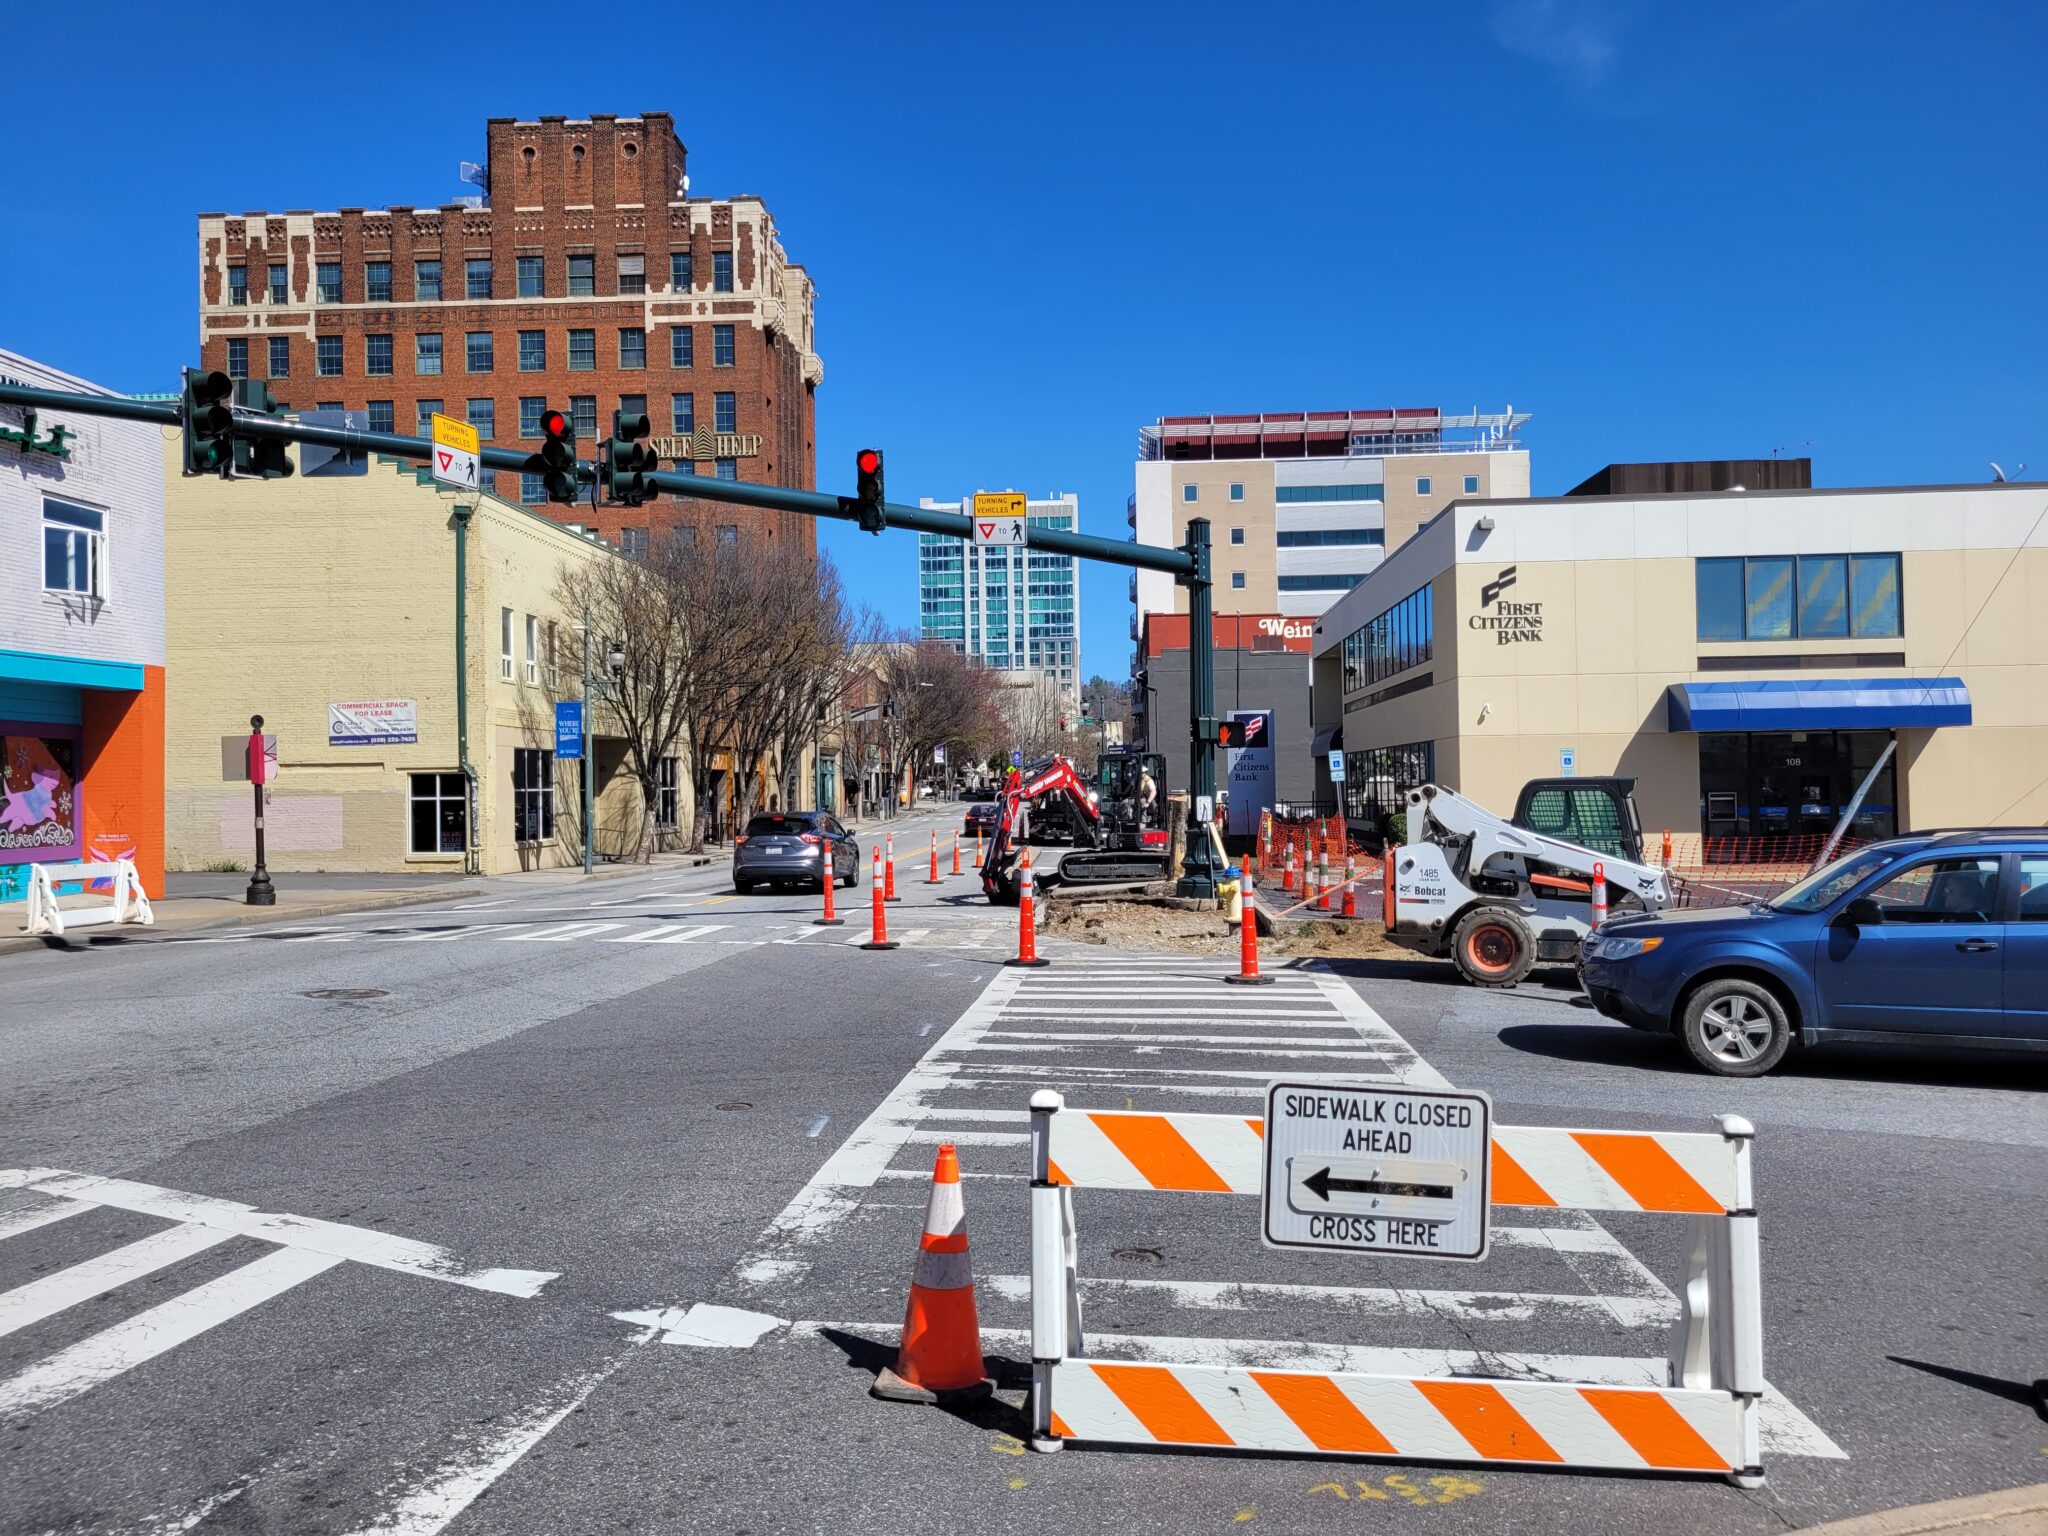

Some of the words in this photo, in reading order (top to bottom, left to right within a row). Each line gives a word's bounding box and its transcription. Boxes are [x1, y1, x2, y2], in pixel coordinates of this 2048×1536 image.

[442, 422, 469, 437] TURNING
[442, 433, 471, 448] VEHICLES
[648, 436, 692, 458] SELF
[716, 435, 763, 457] HELP
[455, 462, 463, 472] TO
[1496, 601, 1543, 616] FIRST
[1258, 618, 1313, 638] Wein
[1468, 615, 1543, 630] CITIZENS
[1496, 629, 1544, 646] BANK
[1234, 753, 1256, 761] First
[1785, 758, 1801, 766] 108
[1234, 763, 1270, 771] Citizens
[1234, 773, 1258, 781] Bank
[1419, 869, 1439, 878] 1485
[1414, 885, 1446, 896] Bobcat
[1285, 1094, 1387, 1123] SIDEWALK
[1394, 1101, 1472, 1129] CLOSED
[1342, 1128, 1412, 1154] AHEAD
[1309, 1215, 1377, 1243] CROSS
[1387, 1220, 1440, 1247] HERE
